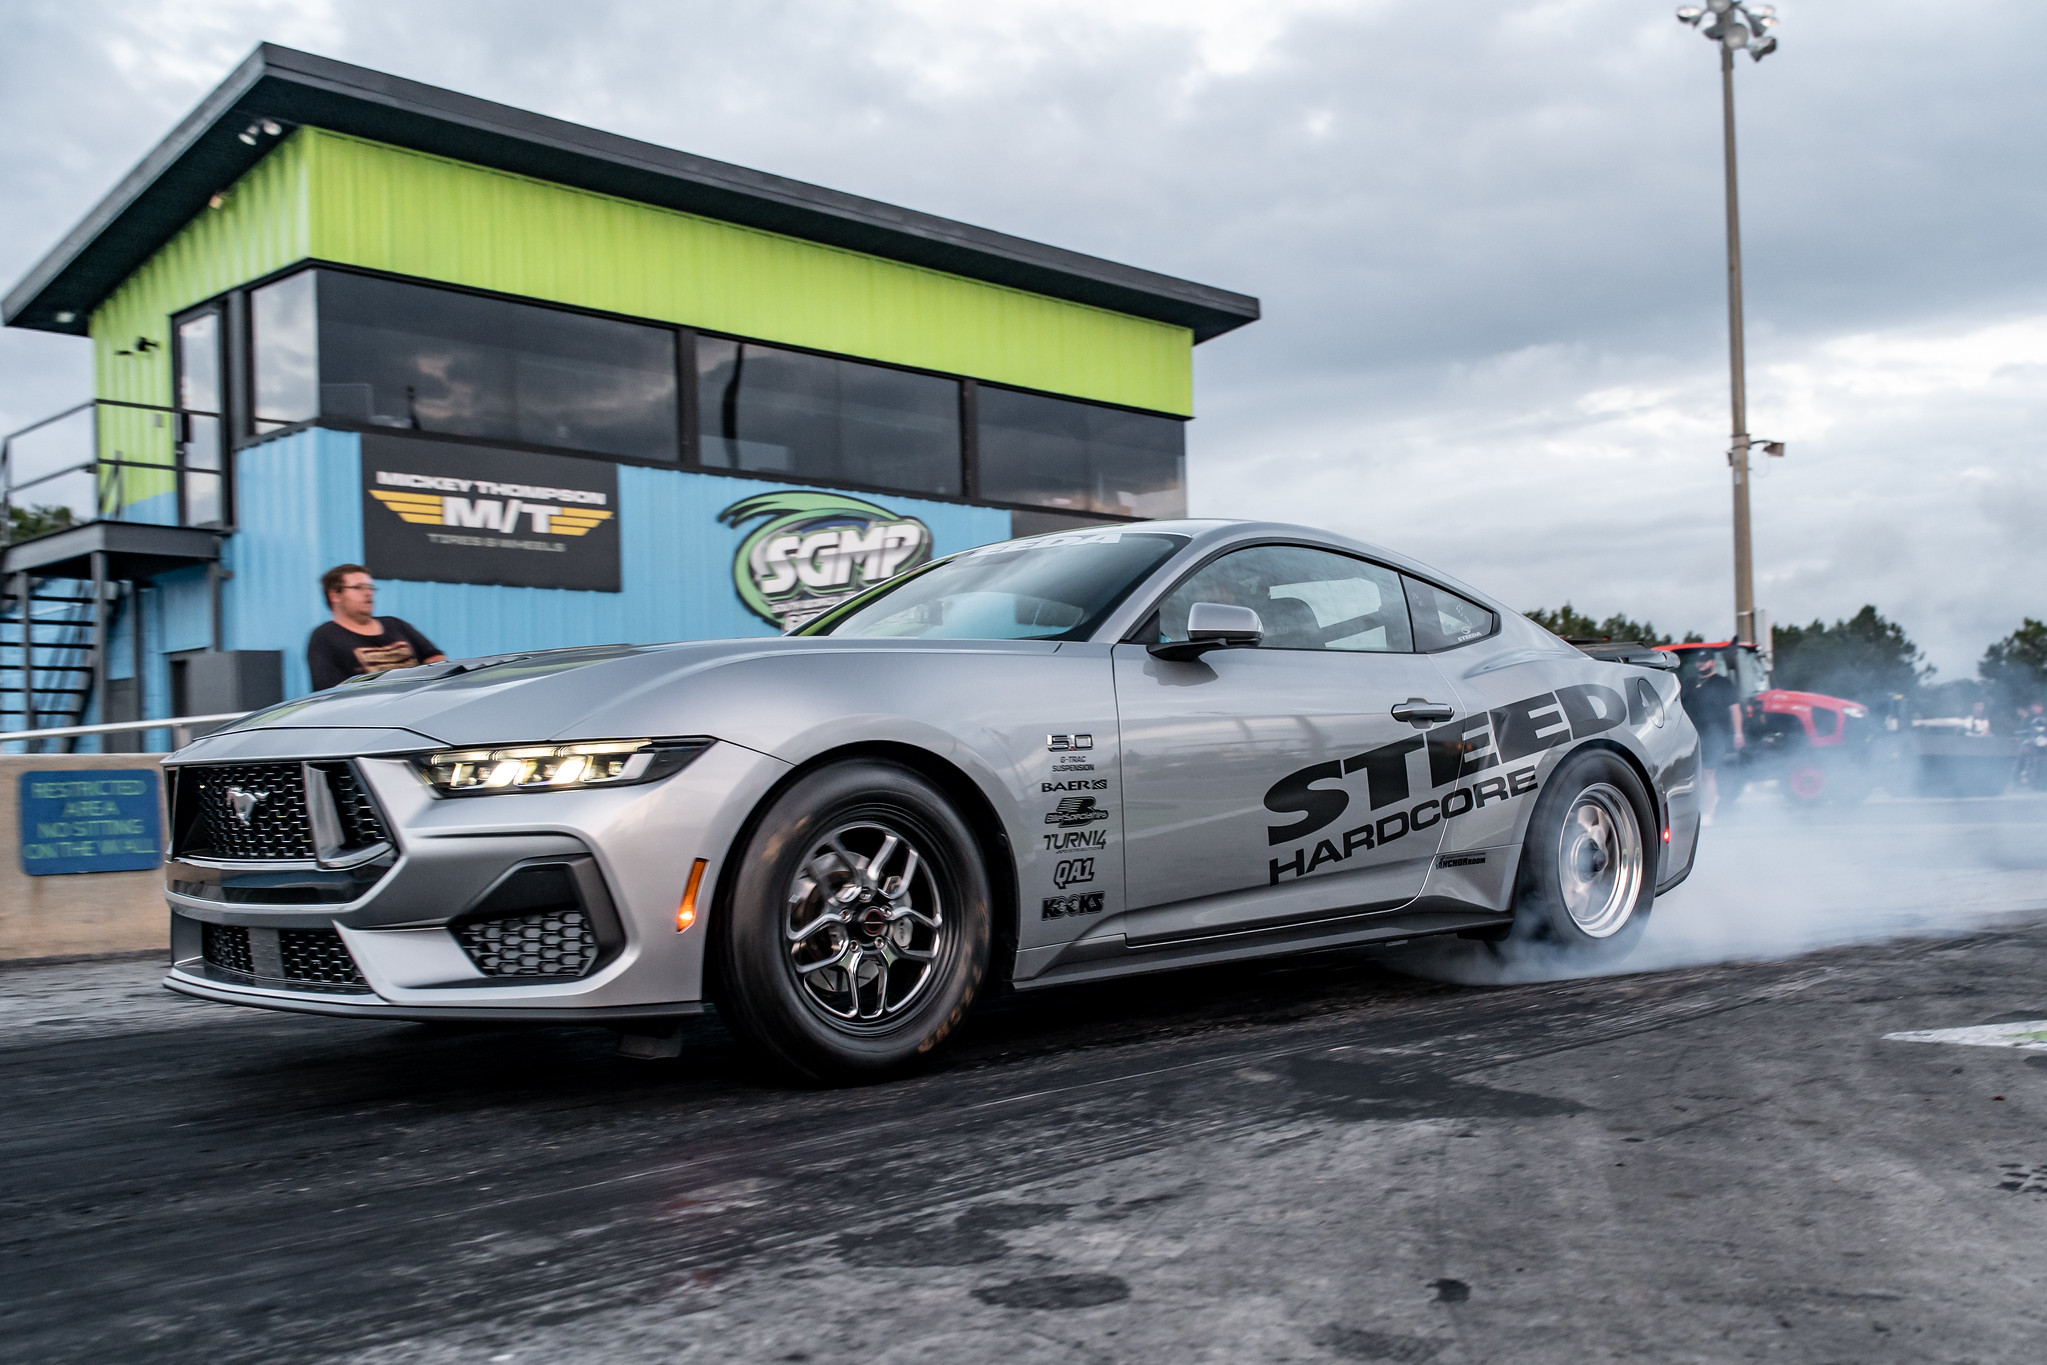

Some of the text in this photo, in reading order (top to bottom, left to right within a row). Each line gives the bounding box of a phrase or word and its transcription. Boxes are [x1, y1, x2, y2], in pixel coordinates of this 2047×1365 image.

[375, 471, 607, 506] MICKEY THOMPSON
[443, 496, 563, 534] M/T
[761, 524, 921, 594] SGMP
[1046, 734, 1094, 751] 5.0
[1052, 764, 1095, 772] SUSPENSION
[1263, 675, 1665, 847] STEEDA
[1268, 765, 1539, 887] HARDCORE
[1054, 857, 1095, 889] QA1
[1042, 891, 1105, 920] KOOKS
